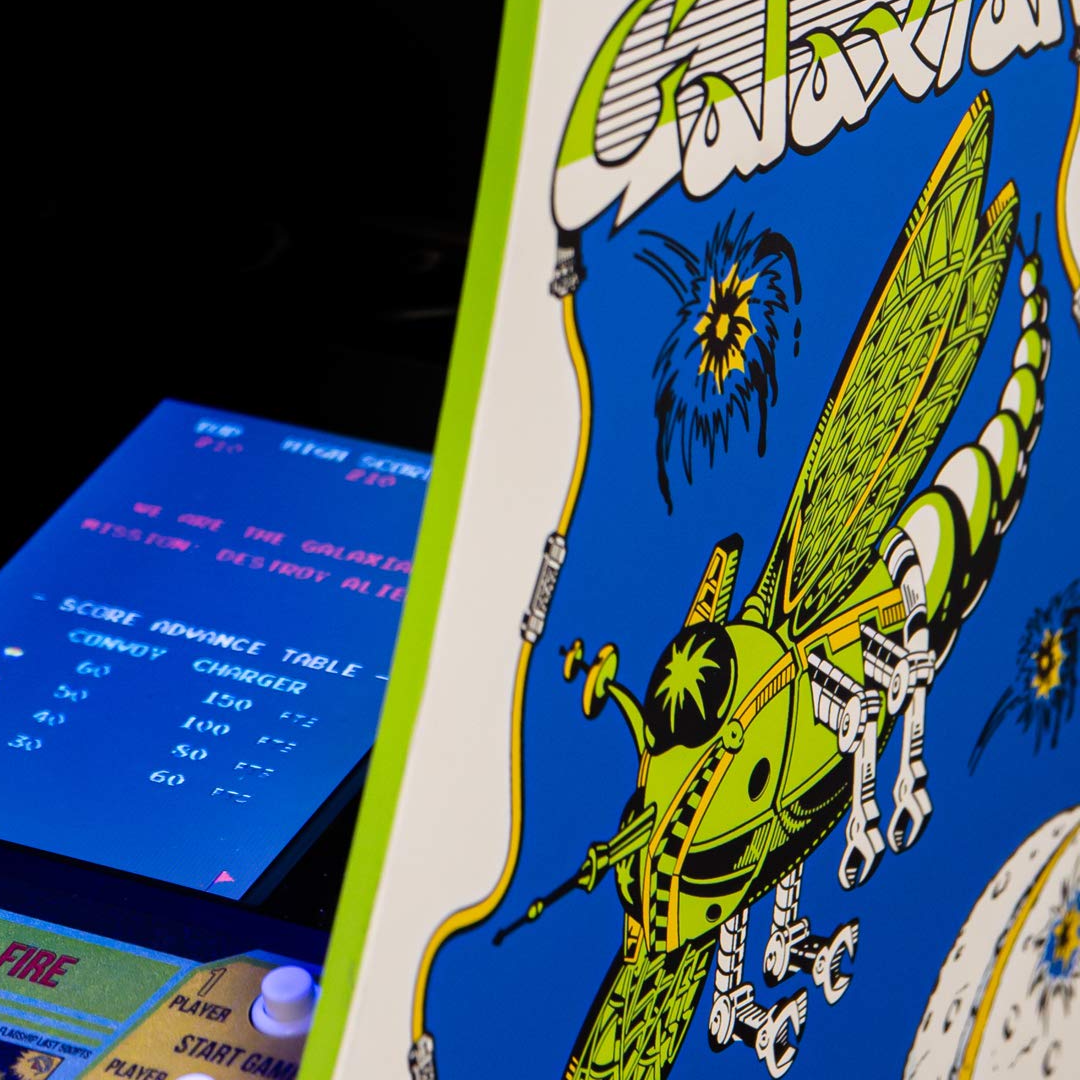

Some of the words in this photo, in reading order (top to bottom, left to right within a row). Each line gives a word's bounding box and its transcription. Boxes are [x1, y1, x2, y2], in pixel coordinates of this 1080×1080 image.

[280, 439, 350, 463] HIGH
[177, 514, 223, 532] ARE
[243, 526, 287, 546] THE
[300, 540, 414, 574] GALAXIA
[215, 548, 331, 583] DESTROY
[59, 597, 143, 626] SCORE
[150, 620, 267, 655] ADVANCE
[281, 648, 363, 679] TABLE
[67, 628, 168, 662] CONVOY
[192, 658, 308, 696] CHARGER
[201, 691, 254, 712] 150
[179, 716, 232, 737] 100
[149, 770, 186, 787] 60
[197, 967, 228, 998] 1
[168, 994, 232, 1023] PLAYER
[35, 1036, 60, 1051] LAST
[173, 1033, 247, 1068] START
